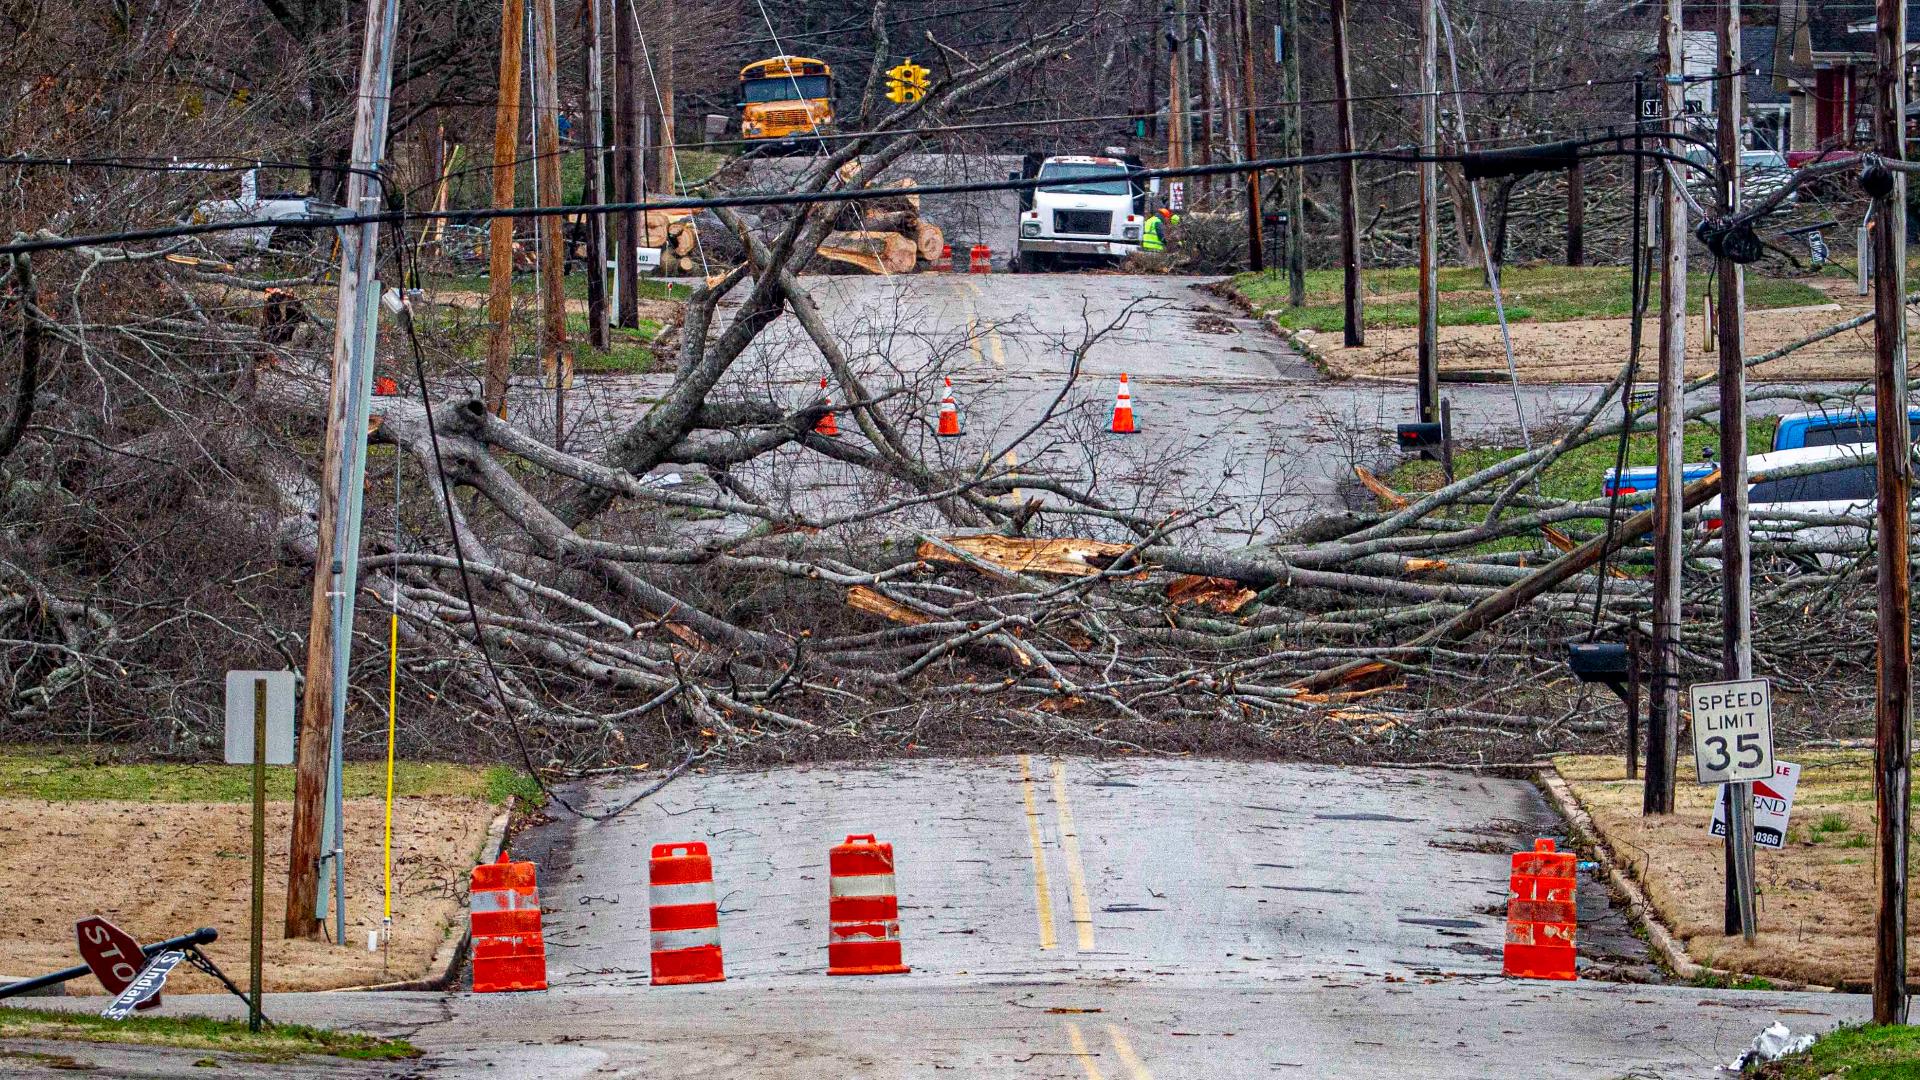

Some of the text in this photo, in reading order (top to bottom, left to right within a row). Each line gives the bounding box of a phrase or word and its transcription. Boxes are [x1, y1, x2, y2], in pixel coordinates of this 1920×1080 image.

[1698, 691, 1763, 711] SPEED
[1706, 712, 1755, 731] LIMIT
[1704, 733, 1764, 771] 35
[1775, 765, 1791, 777] LE
[1753, 795, 1787, 813] END
[84, 925, 138, 983] STO
[120, 967, 168, 1004] Indian
